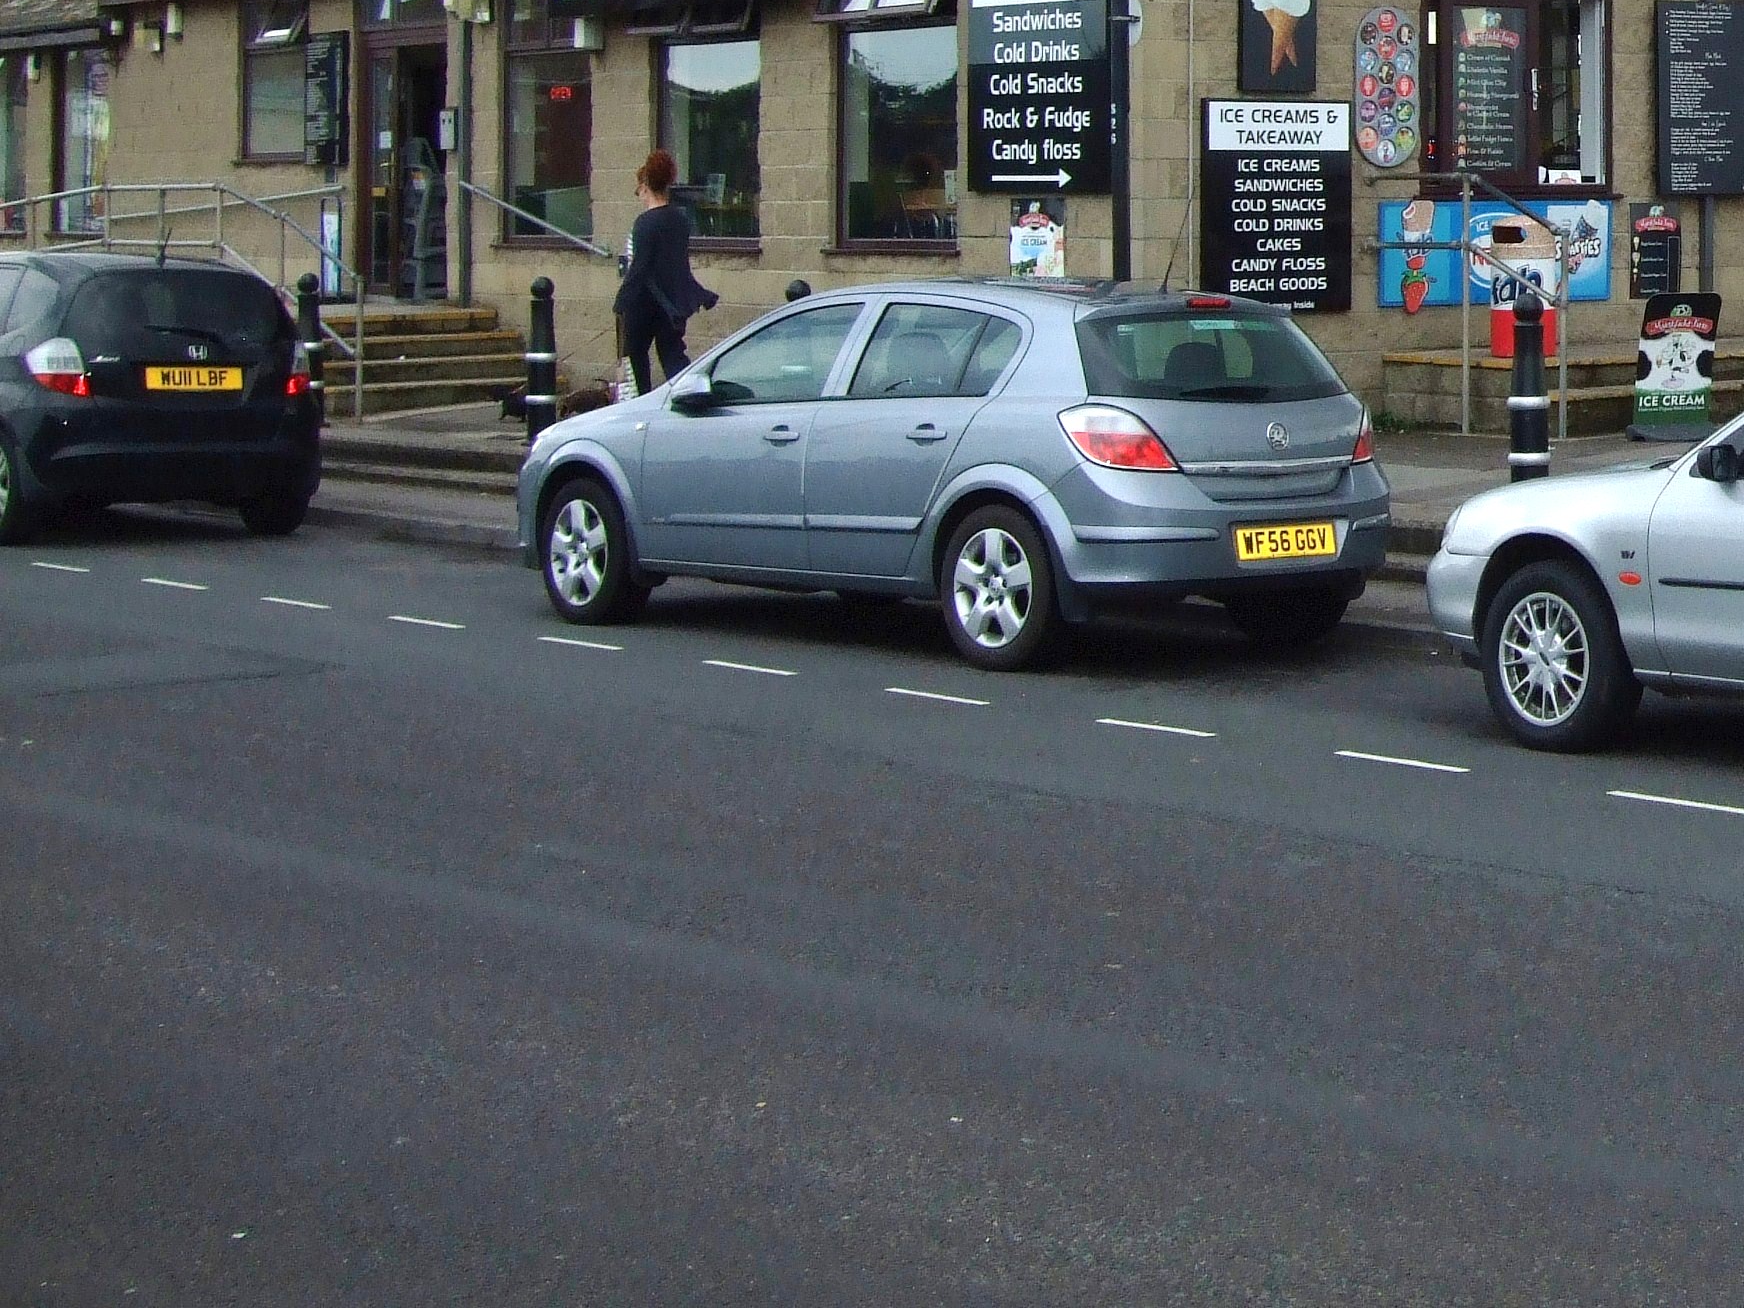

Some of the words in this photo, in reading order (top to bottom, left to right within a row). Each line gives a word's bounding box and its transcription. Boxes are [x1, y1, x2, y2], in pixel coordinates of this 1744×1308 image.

[992, 8, 1083, 34] Sandwiches
[994, 41, 1026, 64] Cold
[1031, 39, 1080, 62] Drinks
[990, 73, 1022, 96] Cold
[1027, 71, 1083, 95] Snacks
[983, 107, 1021, 130] Rock
[1025, 106, 1039, 128] &
[1044, 105, 1091, 132] Fudge
[1219, 108, 1244, 123] ICE
[1251, 109, 1320, 124] CREAMS
[1326, 110, 1339, 124] &
[1235, 129, 1323, 145] TAKEAWAY
[992, 138, 1037, 164] Candy
[1042, 138, 1082, 160] floss
[1237, 159, 1259, 172] ICE
[1263, 159, 1320, 172] CREAMS
[1234, 179, 1324, 192] SANDWICHES
[1231, 199, 1267, 212] COLD
[1271, 198, 1326, 212] SNACKS
[1234, 219, 1269, 232] COLD
[1274, 218, 1324, 231] DRINKS
[1476, 222, 1489, 232] ICE
[1256, 238, 1302, 252] CAKES
[1231, 259, 1278, 272] CANDY
[1281, 257, 1326, 271] FLOSS
[1229, 278, 1275, 293] BEACH
[1279, 277, 1327, 291] GOODS
[161, 370, 192, 386] WU11
[196, 370, 228, 386] LBF
[1639, 395, 1659, 407] ICE
[1662, 394, 1706, 406] CREAM
[1243, 530, 1291, 555] WF56
[1294, 527, 1326, 551] GGV
